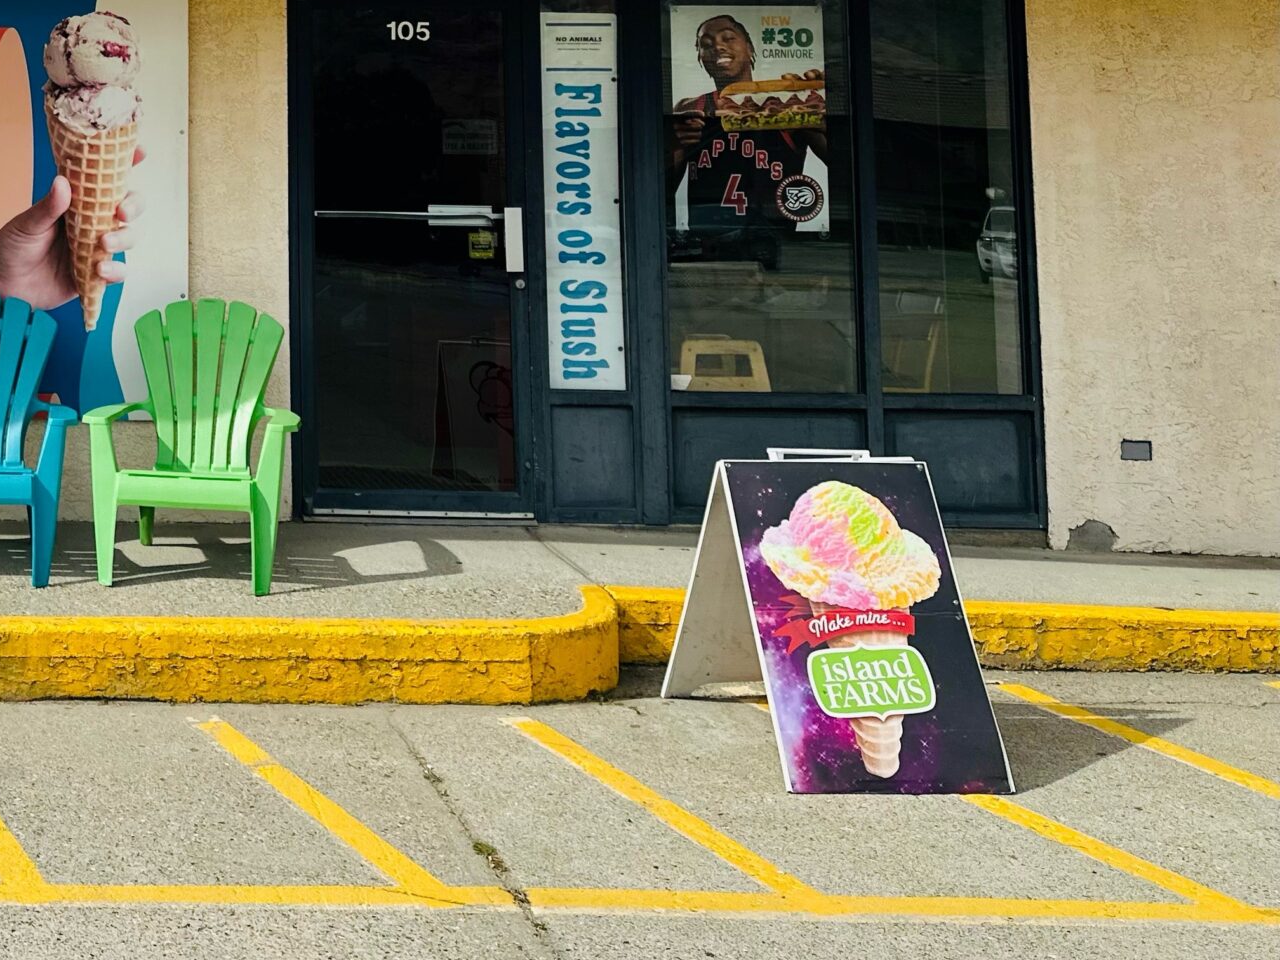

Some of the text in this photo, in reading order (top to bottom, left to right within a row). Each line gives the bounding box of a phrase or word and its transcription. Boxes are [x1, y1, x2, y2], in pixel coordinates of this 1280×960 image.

[386, 21, 430, 41] 105
[761, 16, 790, 26] NEW
[762, 28, 814, 48] #30
[762, 48, 814, 59] CARNIVORE
[555, 83, 602, 215] Flavors
[690, 132, 783, 180] RAPTORS
[721, 174, 747, 215] 4
[557, 229, 607, 265] of
[559, 279, 610, 380] Slush
[808, 613, 854, 638] Make
[820, 651, 916, 683] island
[823, 678, 927, 709] FARMS
